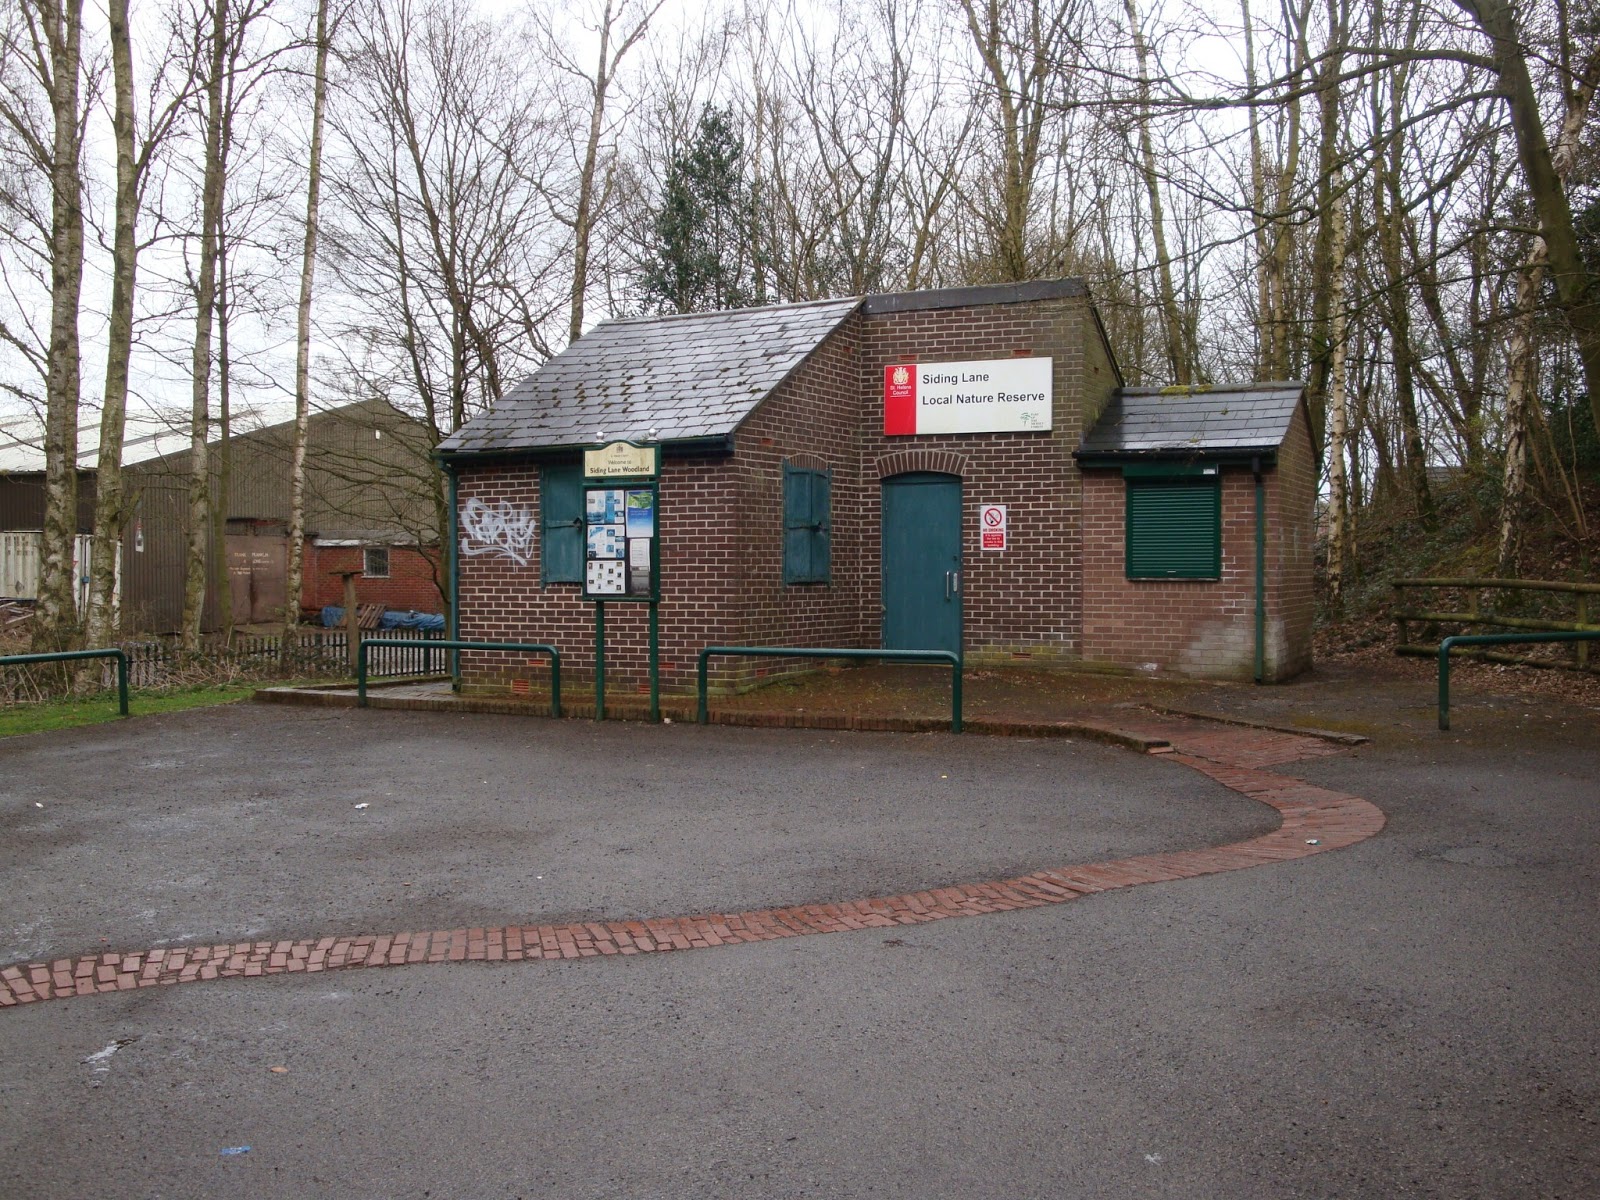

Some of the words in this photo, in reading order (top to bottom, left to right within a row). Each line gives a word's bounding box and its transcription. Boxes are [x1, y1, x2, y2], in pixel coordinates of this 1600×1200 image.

[922, 374, 958, 385] Siding
[962, 372, 990, 383] Lane
[922, 394, 953, 405] Local
[956, 393, 994, 404] Nature
[997, 392, 1045, 402] Reserve
